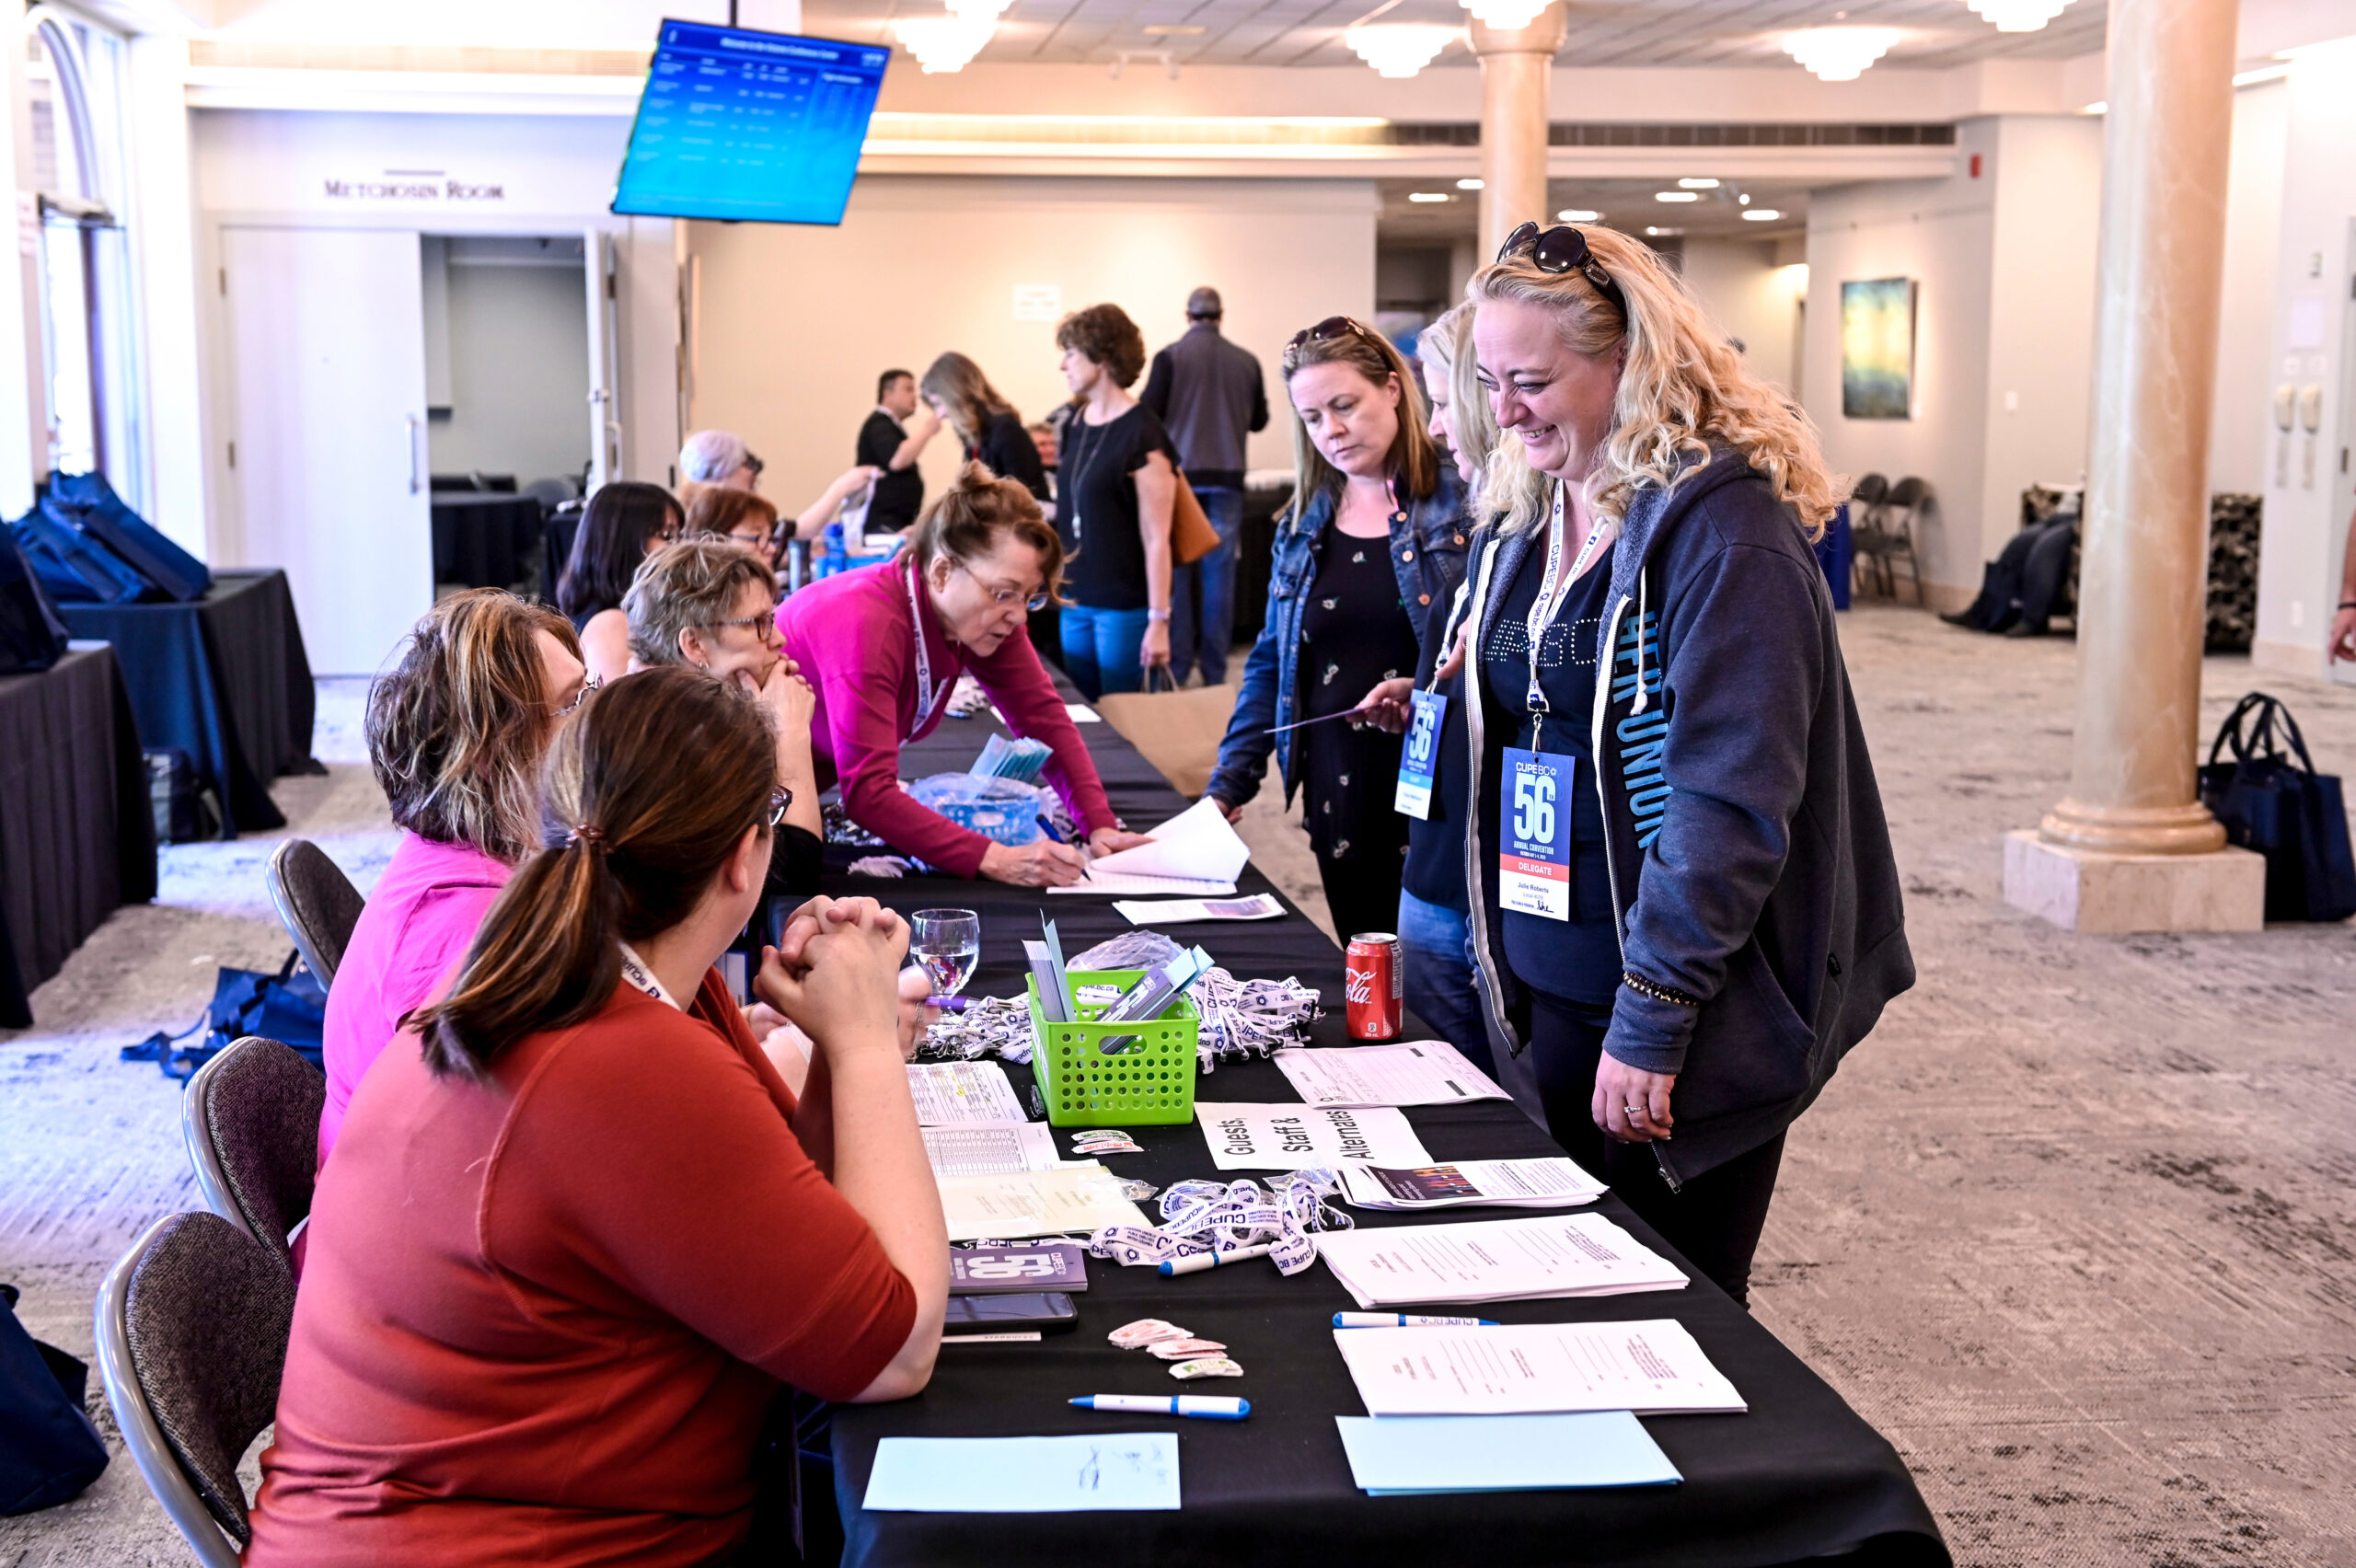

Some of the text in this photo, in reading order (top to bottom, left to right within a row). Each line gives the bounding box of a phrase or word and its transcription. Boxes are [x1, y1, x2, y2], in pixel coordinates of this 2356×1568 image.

[1408, 709, 1436, 762] 56
[1514, 771, 1556, 844] 56
[1519, 861, 1553, 876] DELEGATE
[1530, 884, 1550, 894] Roberts
[1218, 1116, 1256, 1156] Guests,
[1270, 1116, 1314, 1152] Staff &
[1325, 1110, 1375, 1159] Alternates
[966, 1253, 1056, 1279] 56
